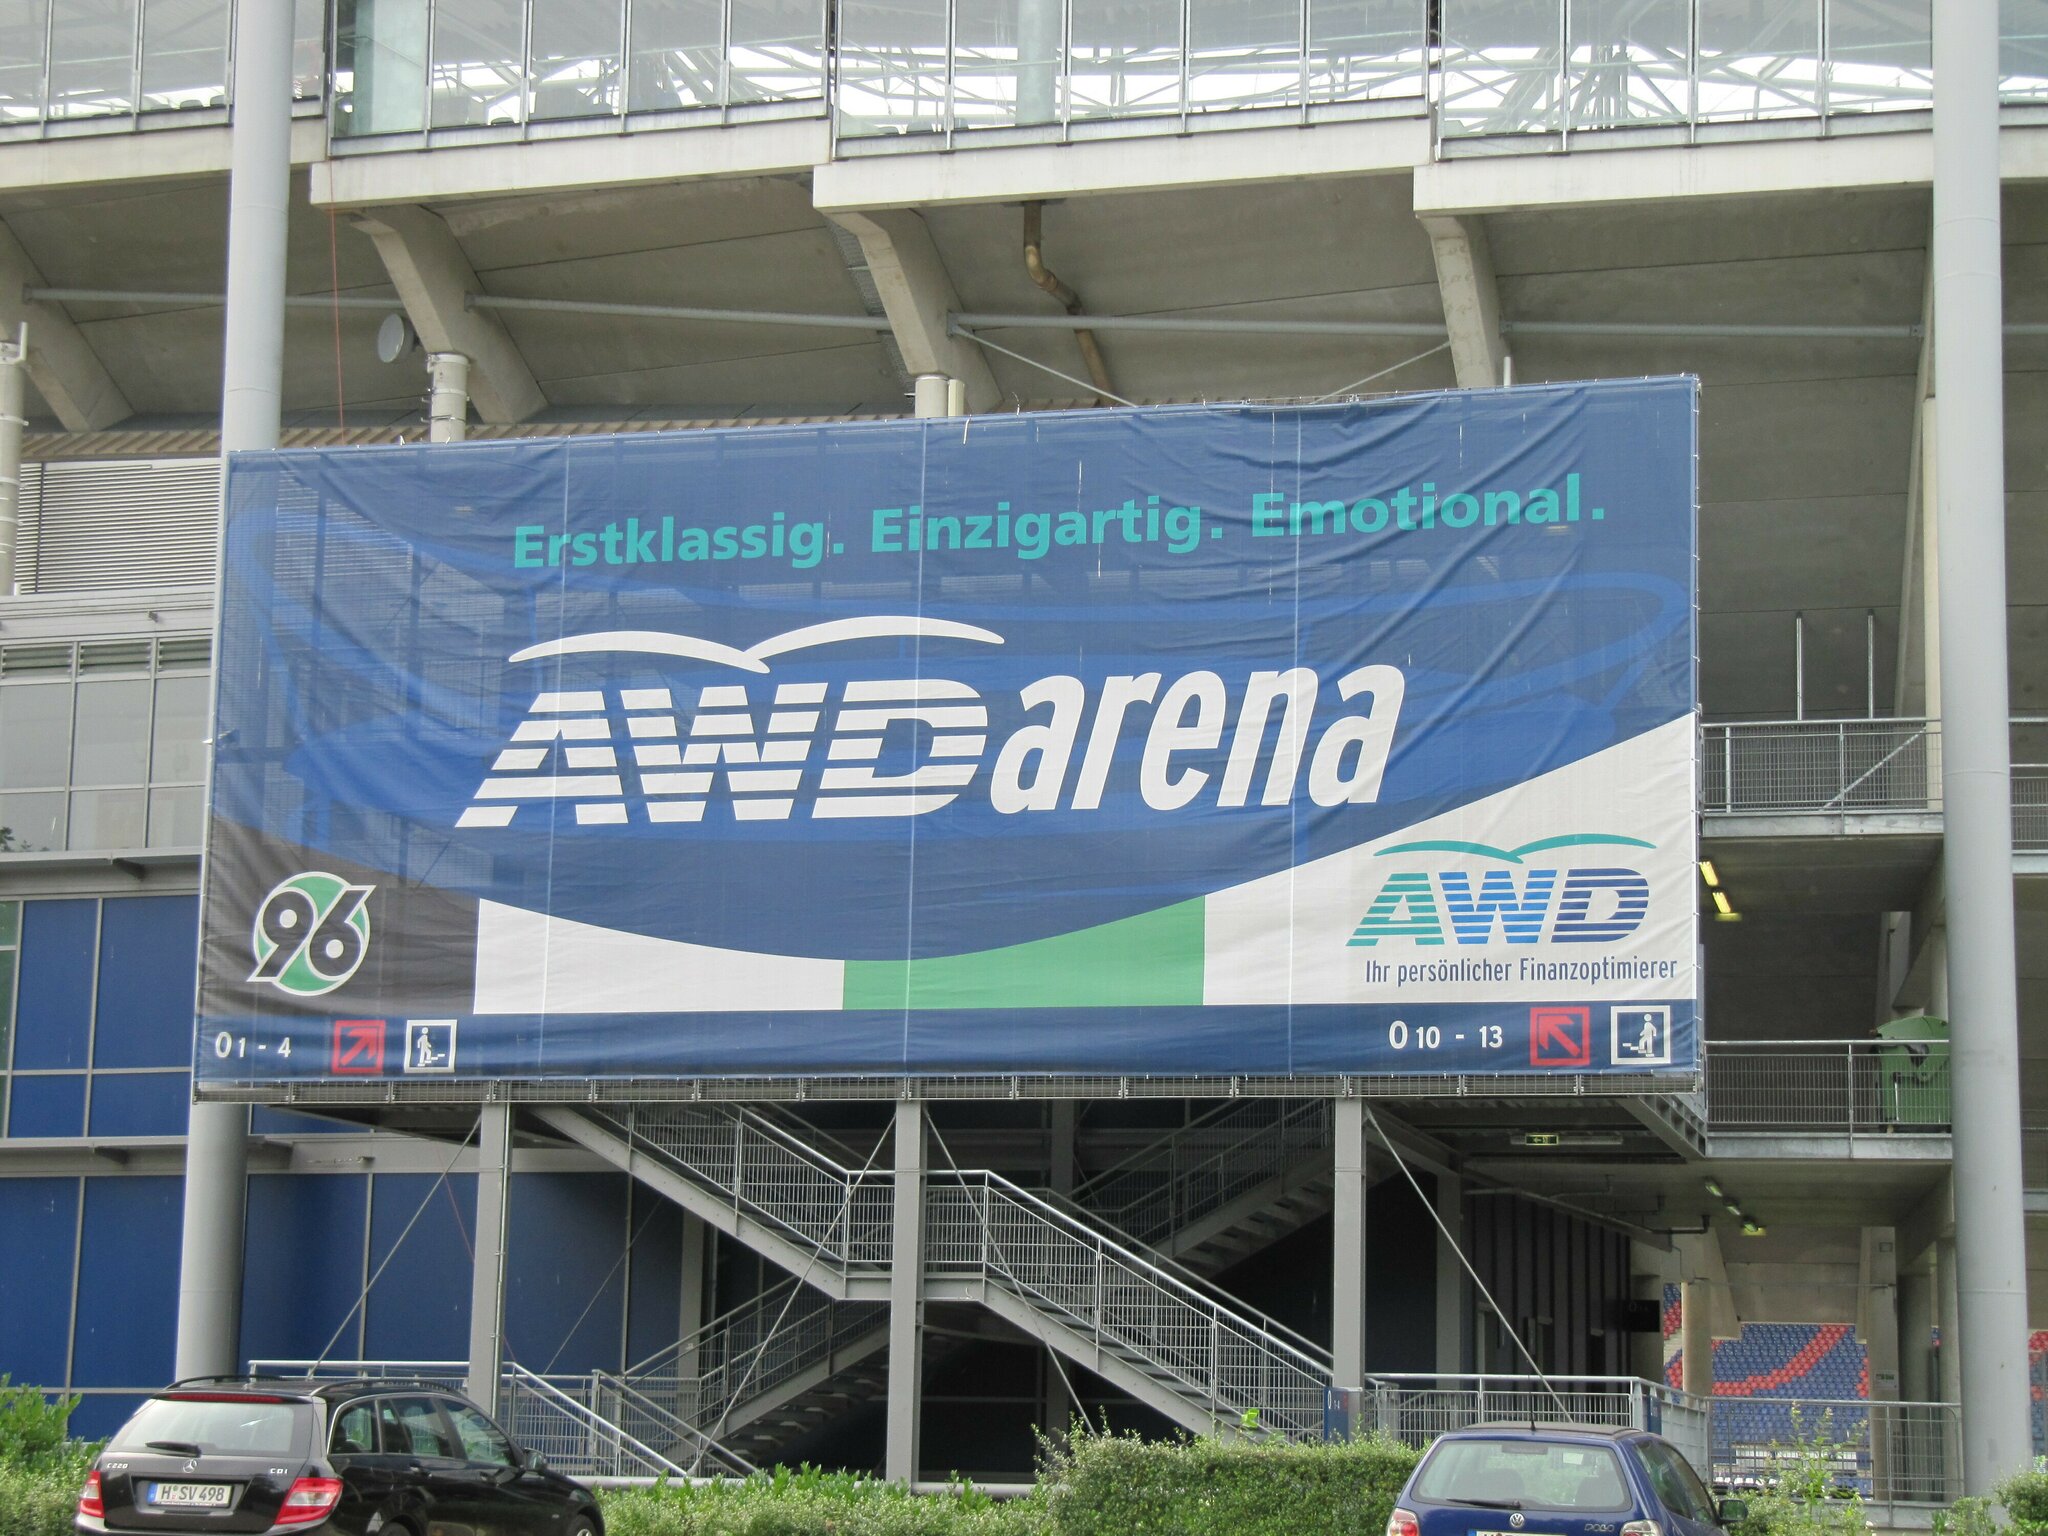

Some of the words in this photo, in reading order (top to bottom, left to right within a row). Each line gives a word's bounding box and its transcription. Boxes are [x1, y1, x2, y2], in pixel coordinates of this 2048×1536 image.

[514, 511, 844, 568] Erstklassig.
[871, 496, 1223, 560] Einzigartig.
[1251, 472, 1605, 538] Emotional.
[455, 679, 988, 829] AWD
[990, 664, 1405, 815] arena
[246, 878, 376, 990] 96
[1345, 867, 1650, 947] AWD
[1365, 959, 1391, 984] Ihr
[1397, 957, 1512, 987] persönlicher
[1519, 956, 1678, 986] Finanzoptimierer
[199, 1486, 225, 1501] 498
